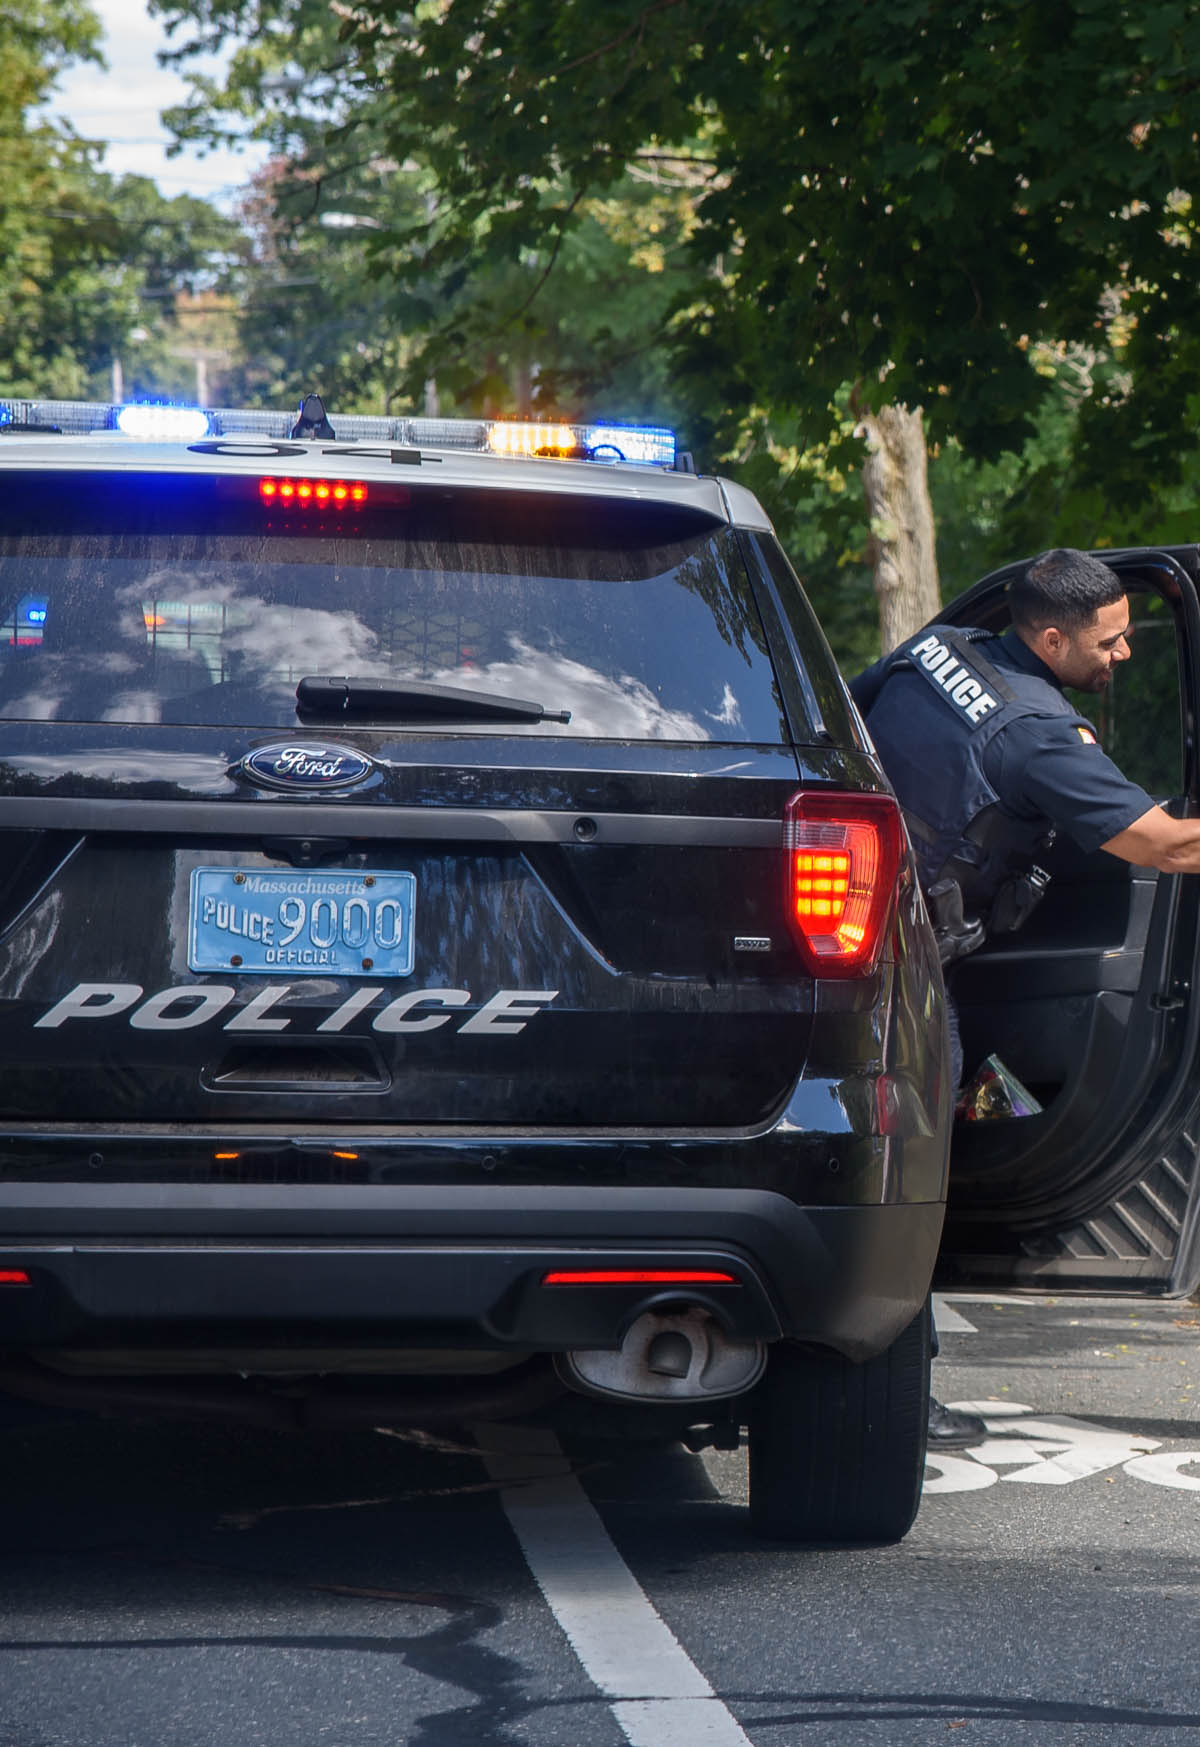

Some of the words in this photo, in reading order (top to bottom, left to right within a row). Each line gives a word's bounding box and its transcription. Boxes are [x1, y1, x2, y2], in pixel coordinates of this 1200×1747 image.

[911, 635, 998, 723] POLICE
[273, 748, 344, 776] Ford
[243, 877, 366, 895] Massachusetts
[203, 896, 275, 947] POLICE
[278, 897, 403, 950] 9000
[265, 949, 339, 965] OFFICIAL
[33, 983, 560, 1034] POLICE
